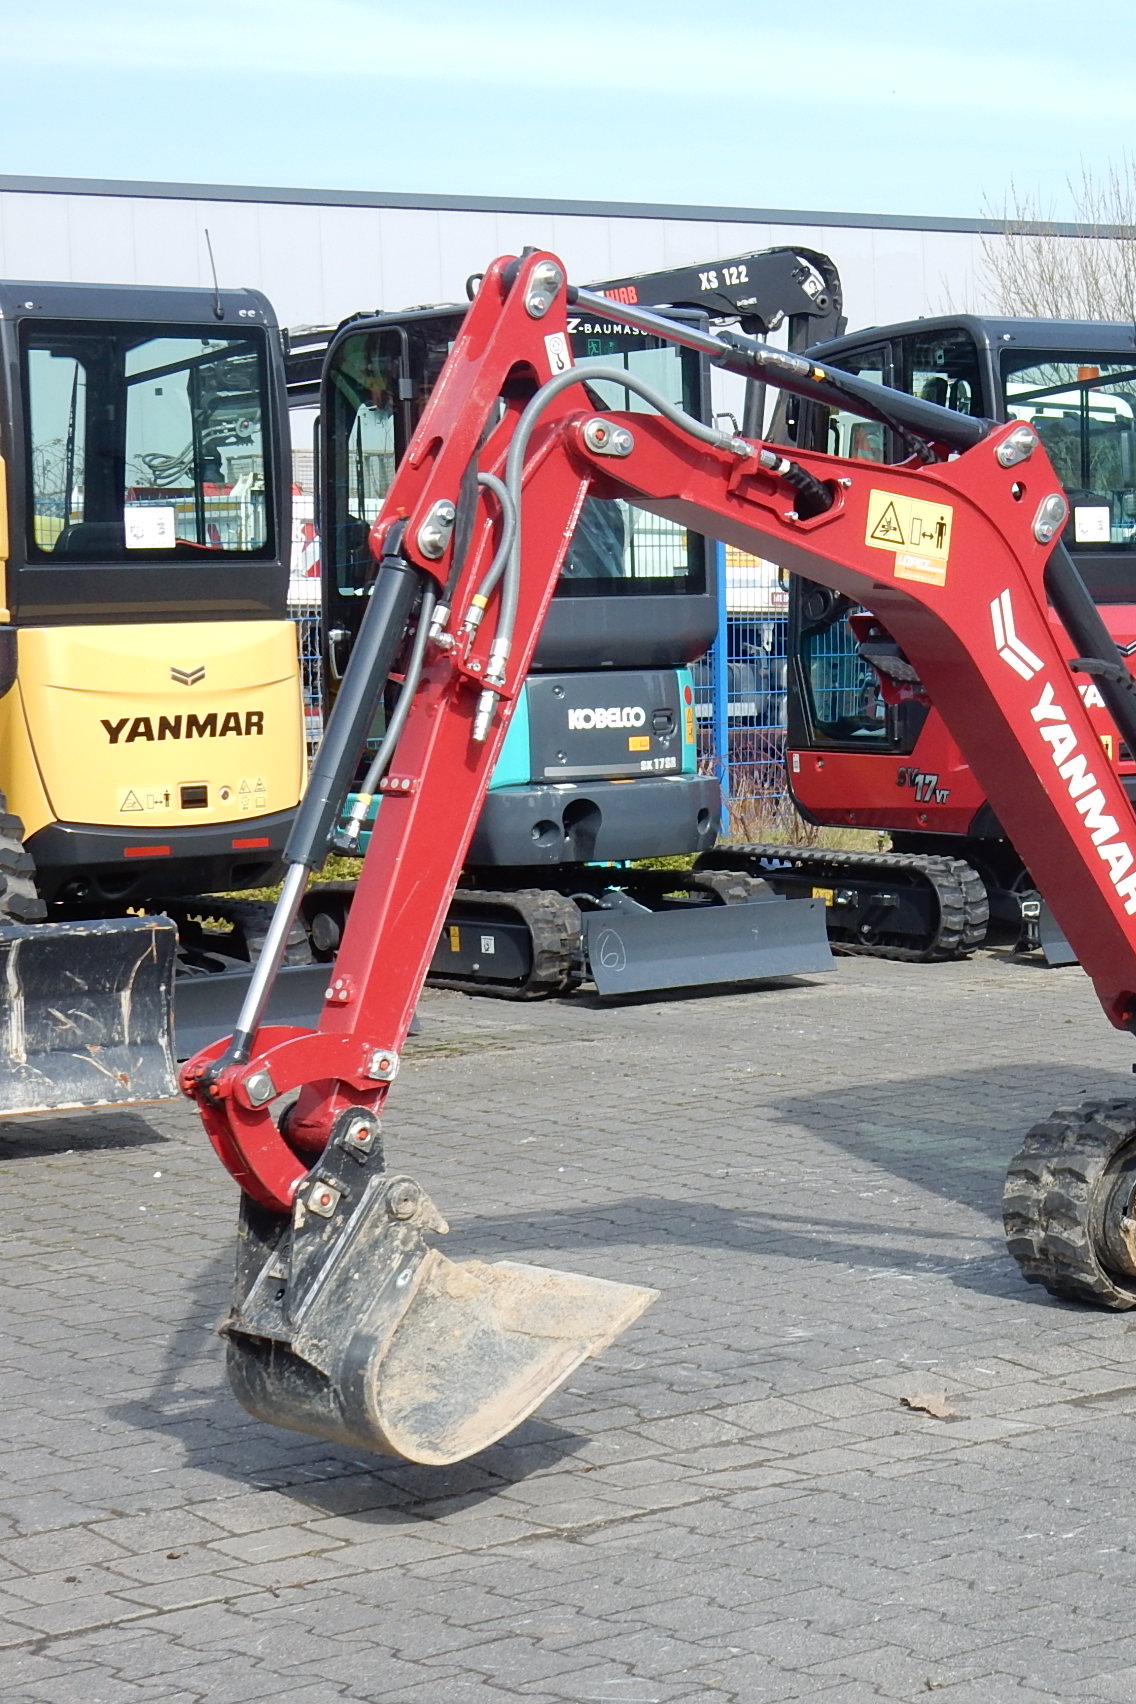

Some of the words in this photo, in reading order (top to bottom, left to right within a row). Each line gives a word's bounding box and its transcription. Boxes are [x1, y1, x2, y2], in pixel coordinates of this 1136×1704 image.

[698, 270, 719, 291] XS
[722, 264, 749, 286] 122
[100, 711, 264, 744] YANMAR
[568, 706, 646, 730] KOBELCO
